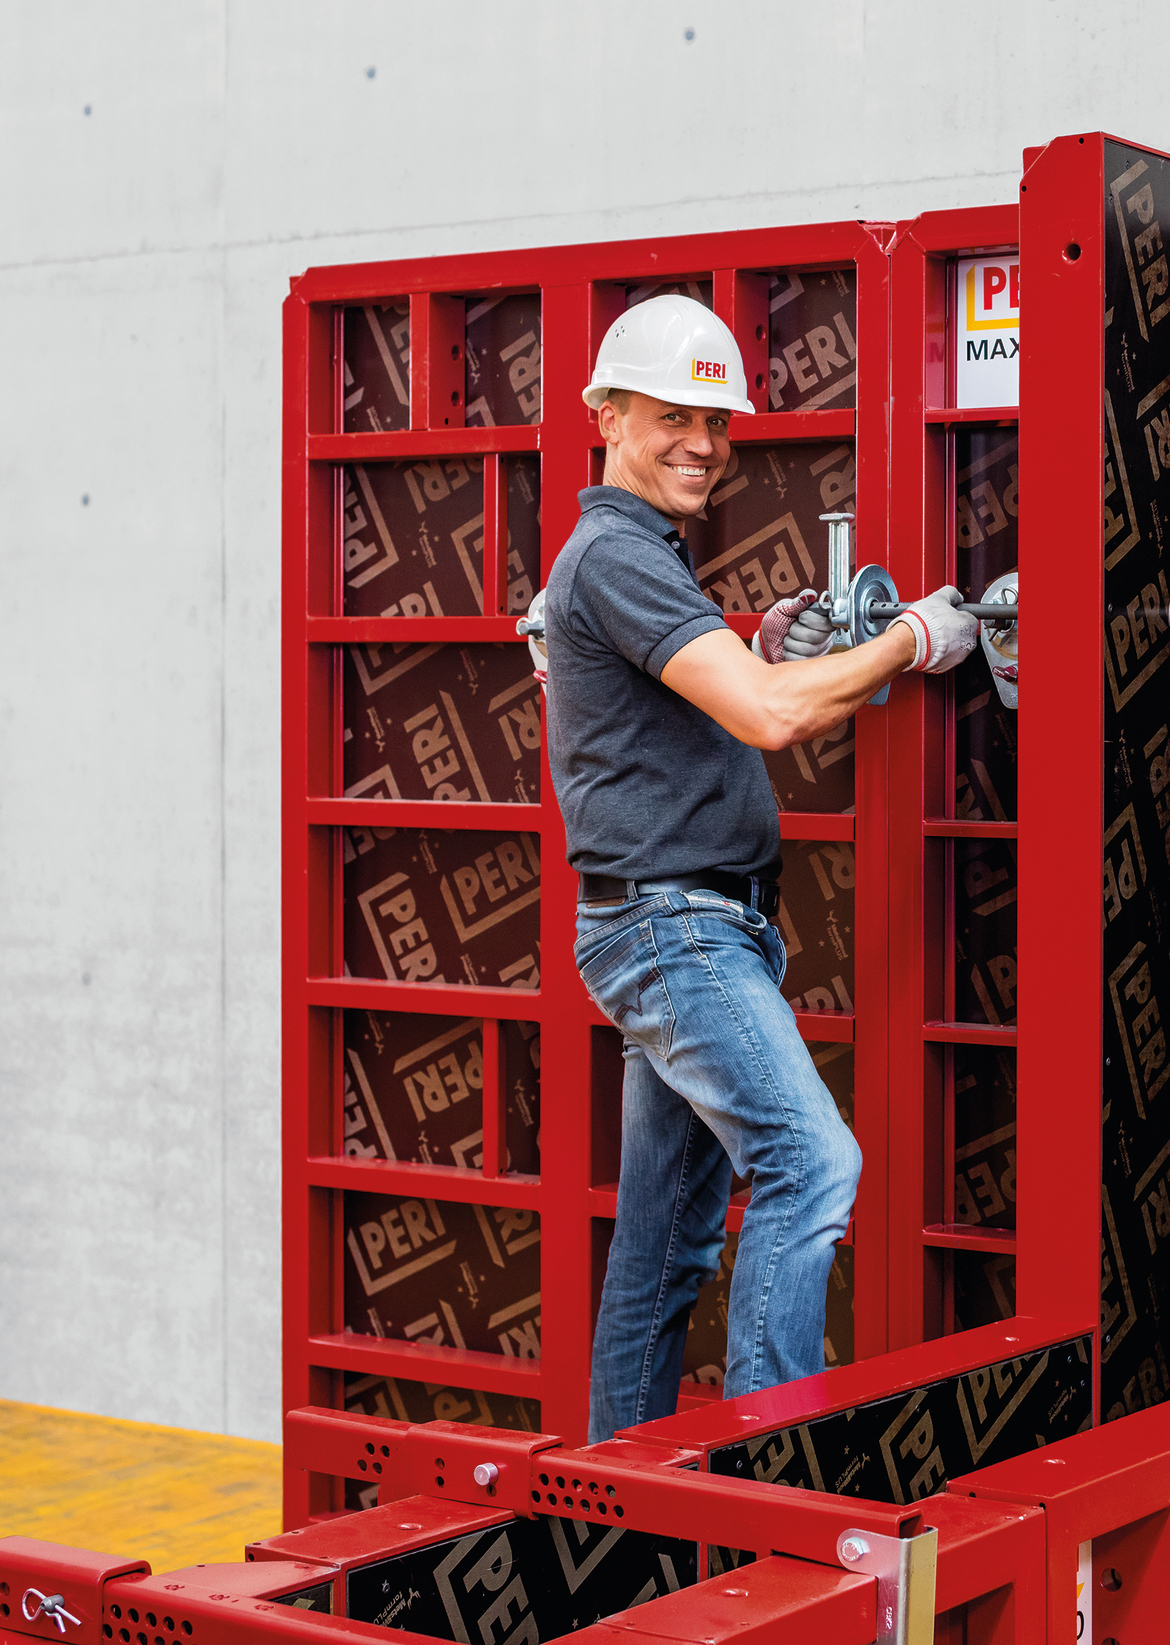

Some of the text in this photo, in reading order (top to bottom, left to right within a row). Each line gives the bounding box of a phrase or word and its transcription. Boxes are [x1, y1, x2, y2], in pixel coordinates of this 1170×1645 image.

[696, 360, 726, 379] PERI
[1109, 569, 1170, 678] PERI
[453, 832, 541, 916] PERI
[359, 1199, 447, 1270] PERI
